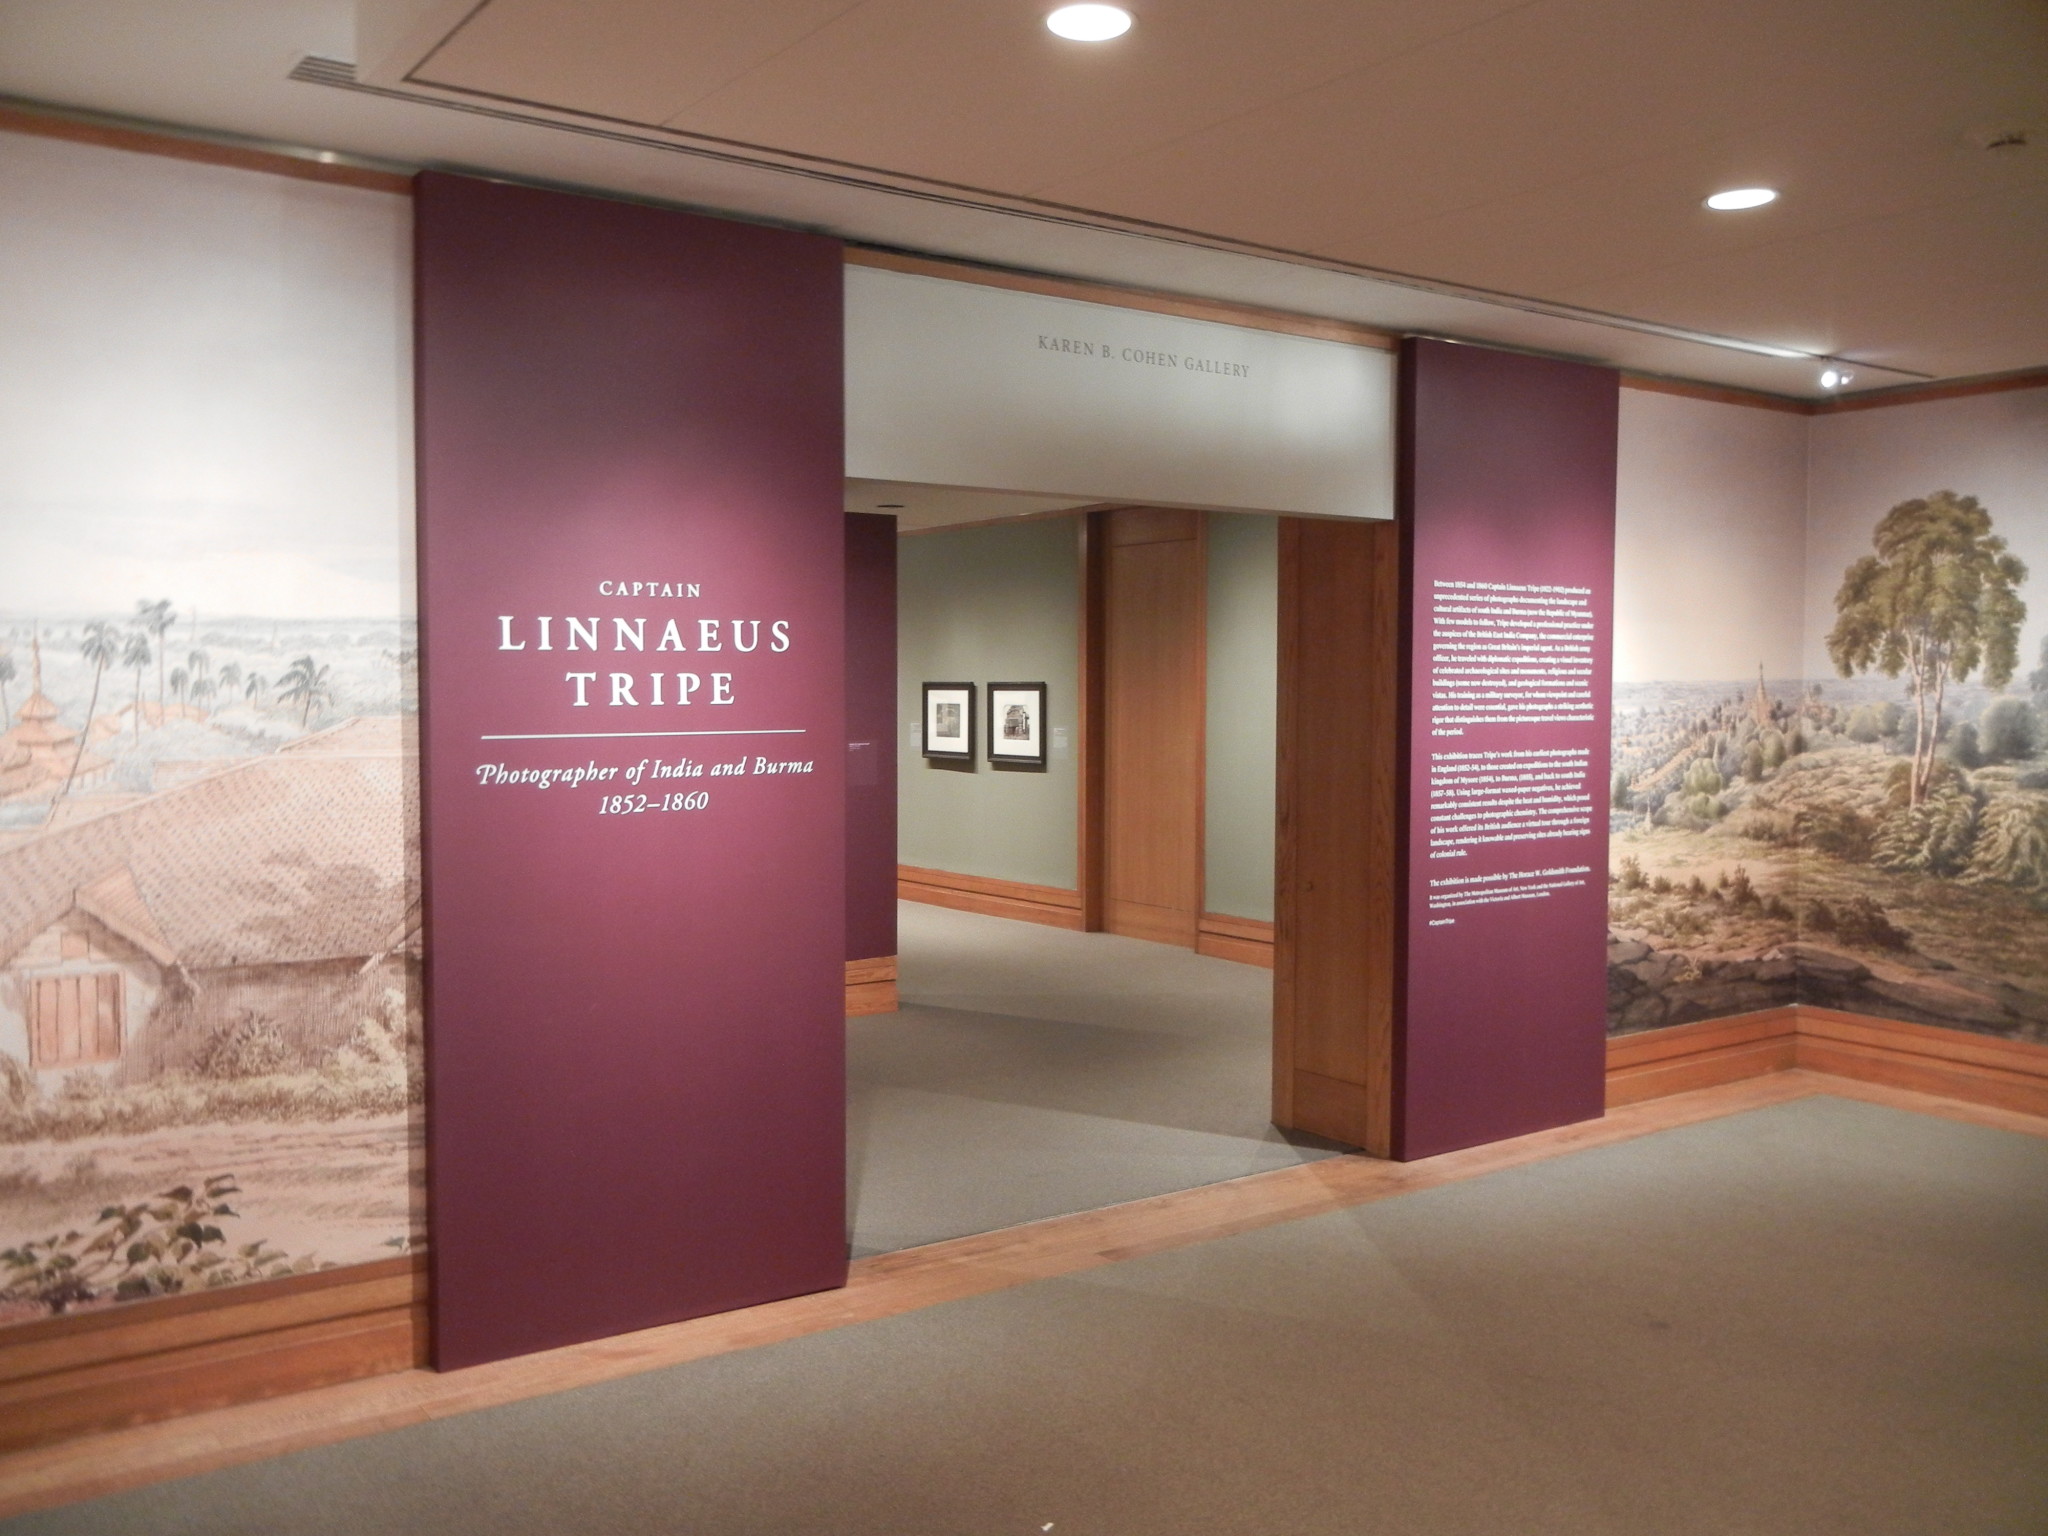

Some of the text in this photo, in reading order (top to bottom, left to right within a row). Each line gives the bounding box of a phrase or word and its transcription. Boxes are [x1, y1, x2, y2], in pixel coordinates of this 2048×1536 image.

[1038, 335, 1249, 378] KAREN B. COHEN GALLERY
[599, 581, 702, 599] CAPTAIN
[498, 616, 791, 654] LINNAEUS
[565, 672, 736, 708] TRIPE
[476, 756, 815, 791] Photographer of India and Burma
